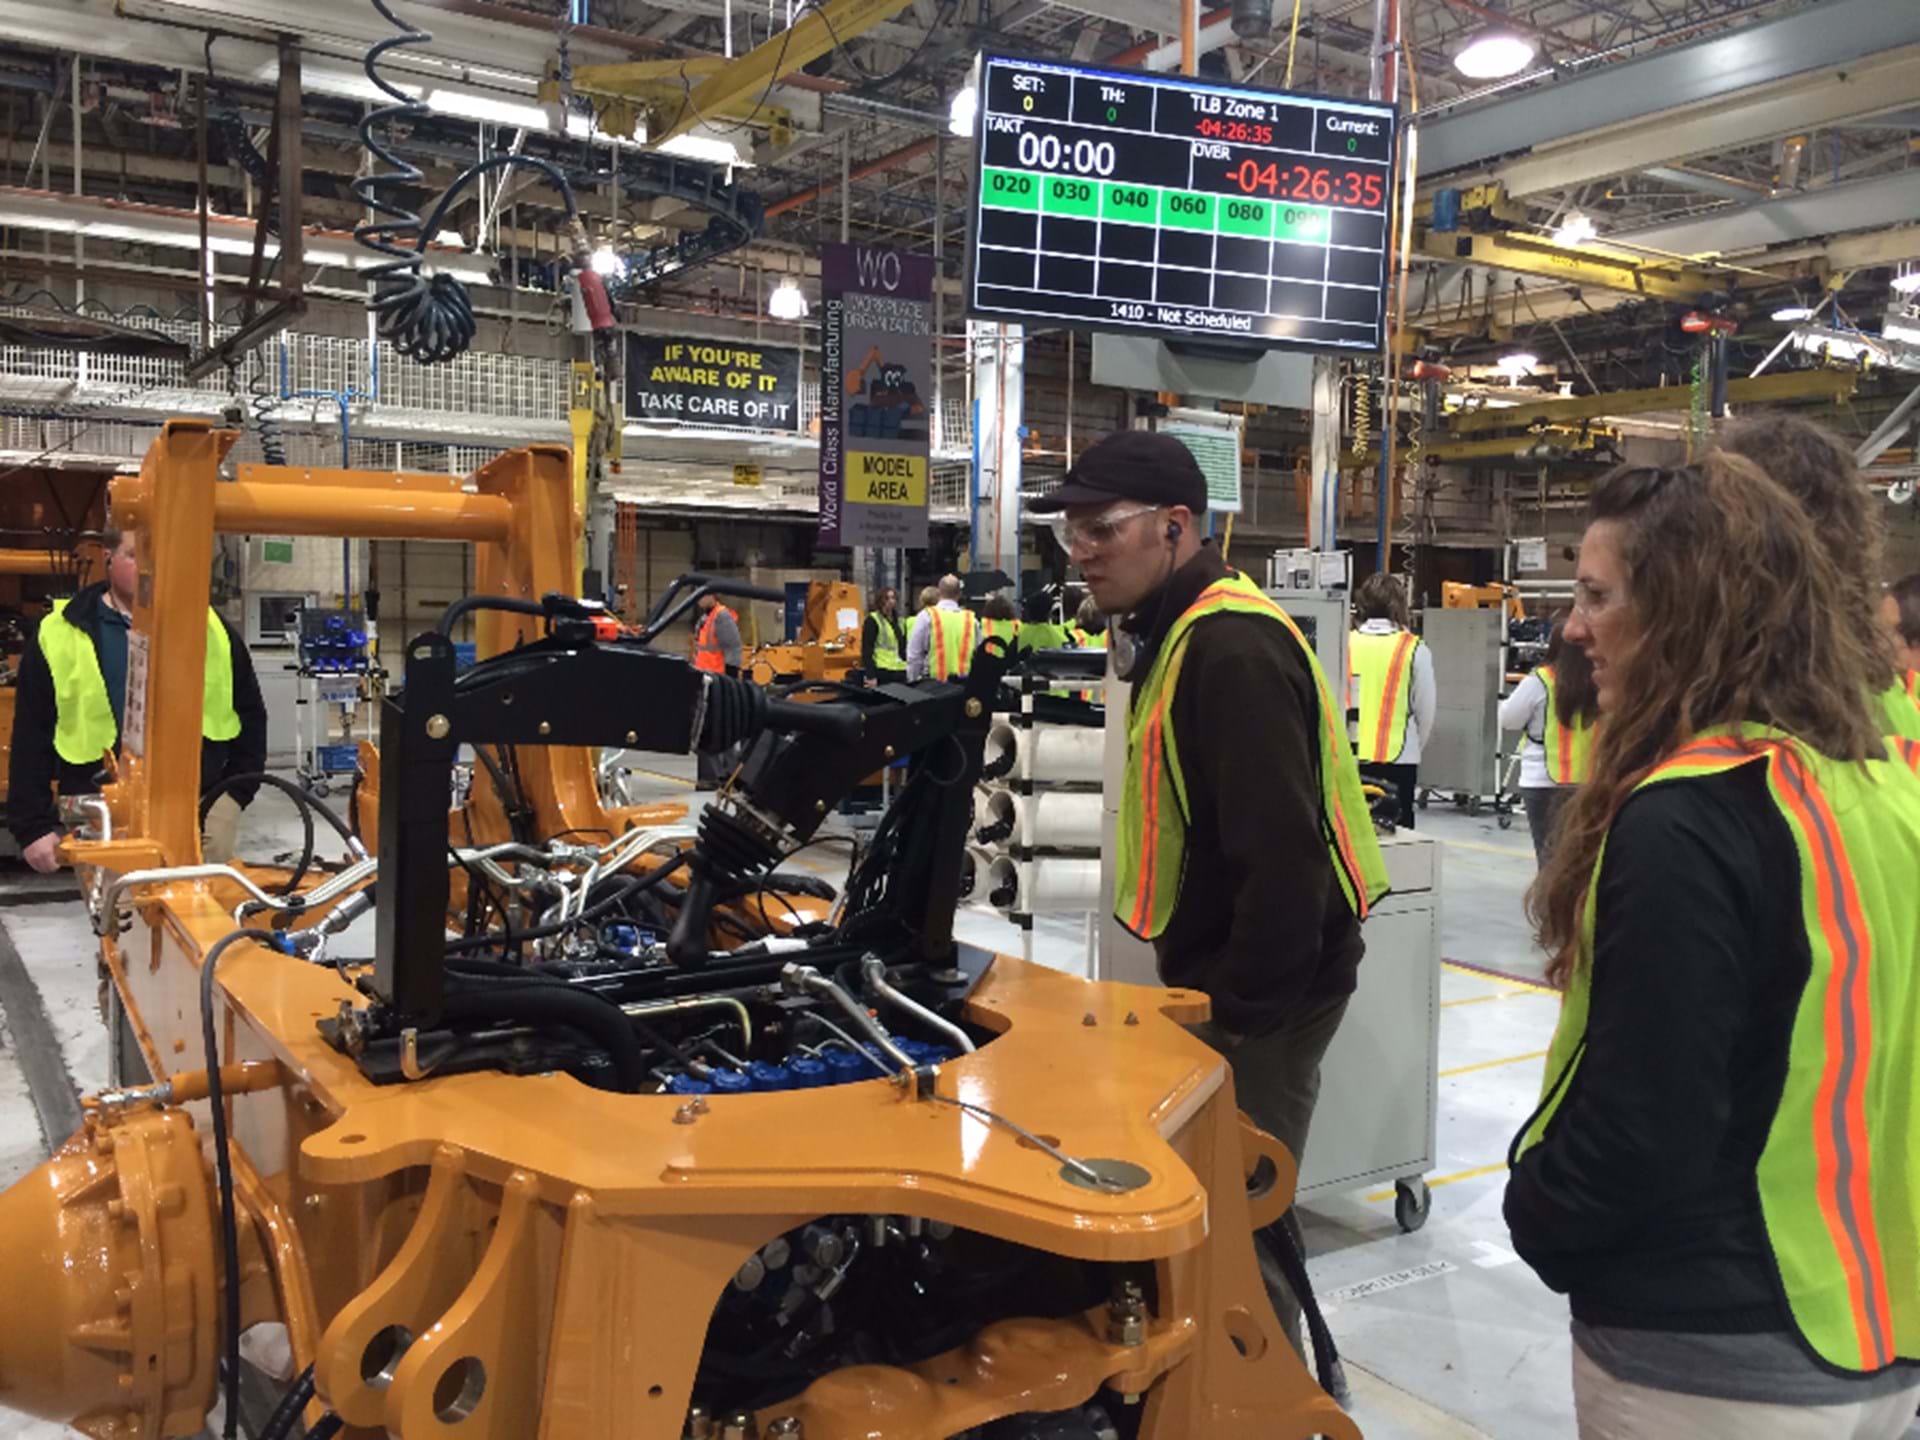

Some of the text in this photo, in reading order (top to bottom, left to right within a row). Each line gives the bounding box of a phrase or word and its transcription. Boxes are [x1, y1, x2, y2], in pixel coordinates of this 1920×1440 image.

[1012, 74, 1046, 93] SET:
[1023, 95, 1034, 112] 0
[1100, 86, 1126, 104] TH:
[1106, 106, 1117, 122] 0
[1190, 94, 1279, 122] TLB Zone 1
[986, 116, 1025, 134] TAKT
[1195, 118, 1273, 144] -04:26:35
[1326, 116, 1380, 136] Current:
[1018, 131, 1115, 177] 00:00
[1193, 142, 1231, 161] OVER
[1347, 137, 1357, 153] 0
[992, 174, 1031, 194] 020
[1053, 181, 1091, 202] 030
[1225, 159, 1383, 207] -04:26:35
[1112, 189, 1149, 208] 040
[1170, 195, 1207, 215] 060
[1228, 202, 1264, 221] 080
[856, 247, 901, 291] WO
[1110, 303, 1144, 319] 1410
[1157, 307, 1182, 324] Not
[1184, 310, 1252, 331] Scheduled
[664, 344, 763, 370] IF YOU'RE
[650, 366, 777, 392] AWARE OF IT
[637, 391, 790, 421] TAKE CARE OF IT
[820, 299, 844, 532] World Class Manufacturing
[863, 455, 914, 478] MODEL
[867, 480, 910, 500] AREA
